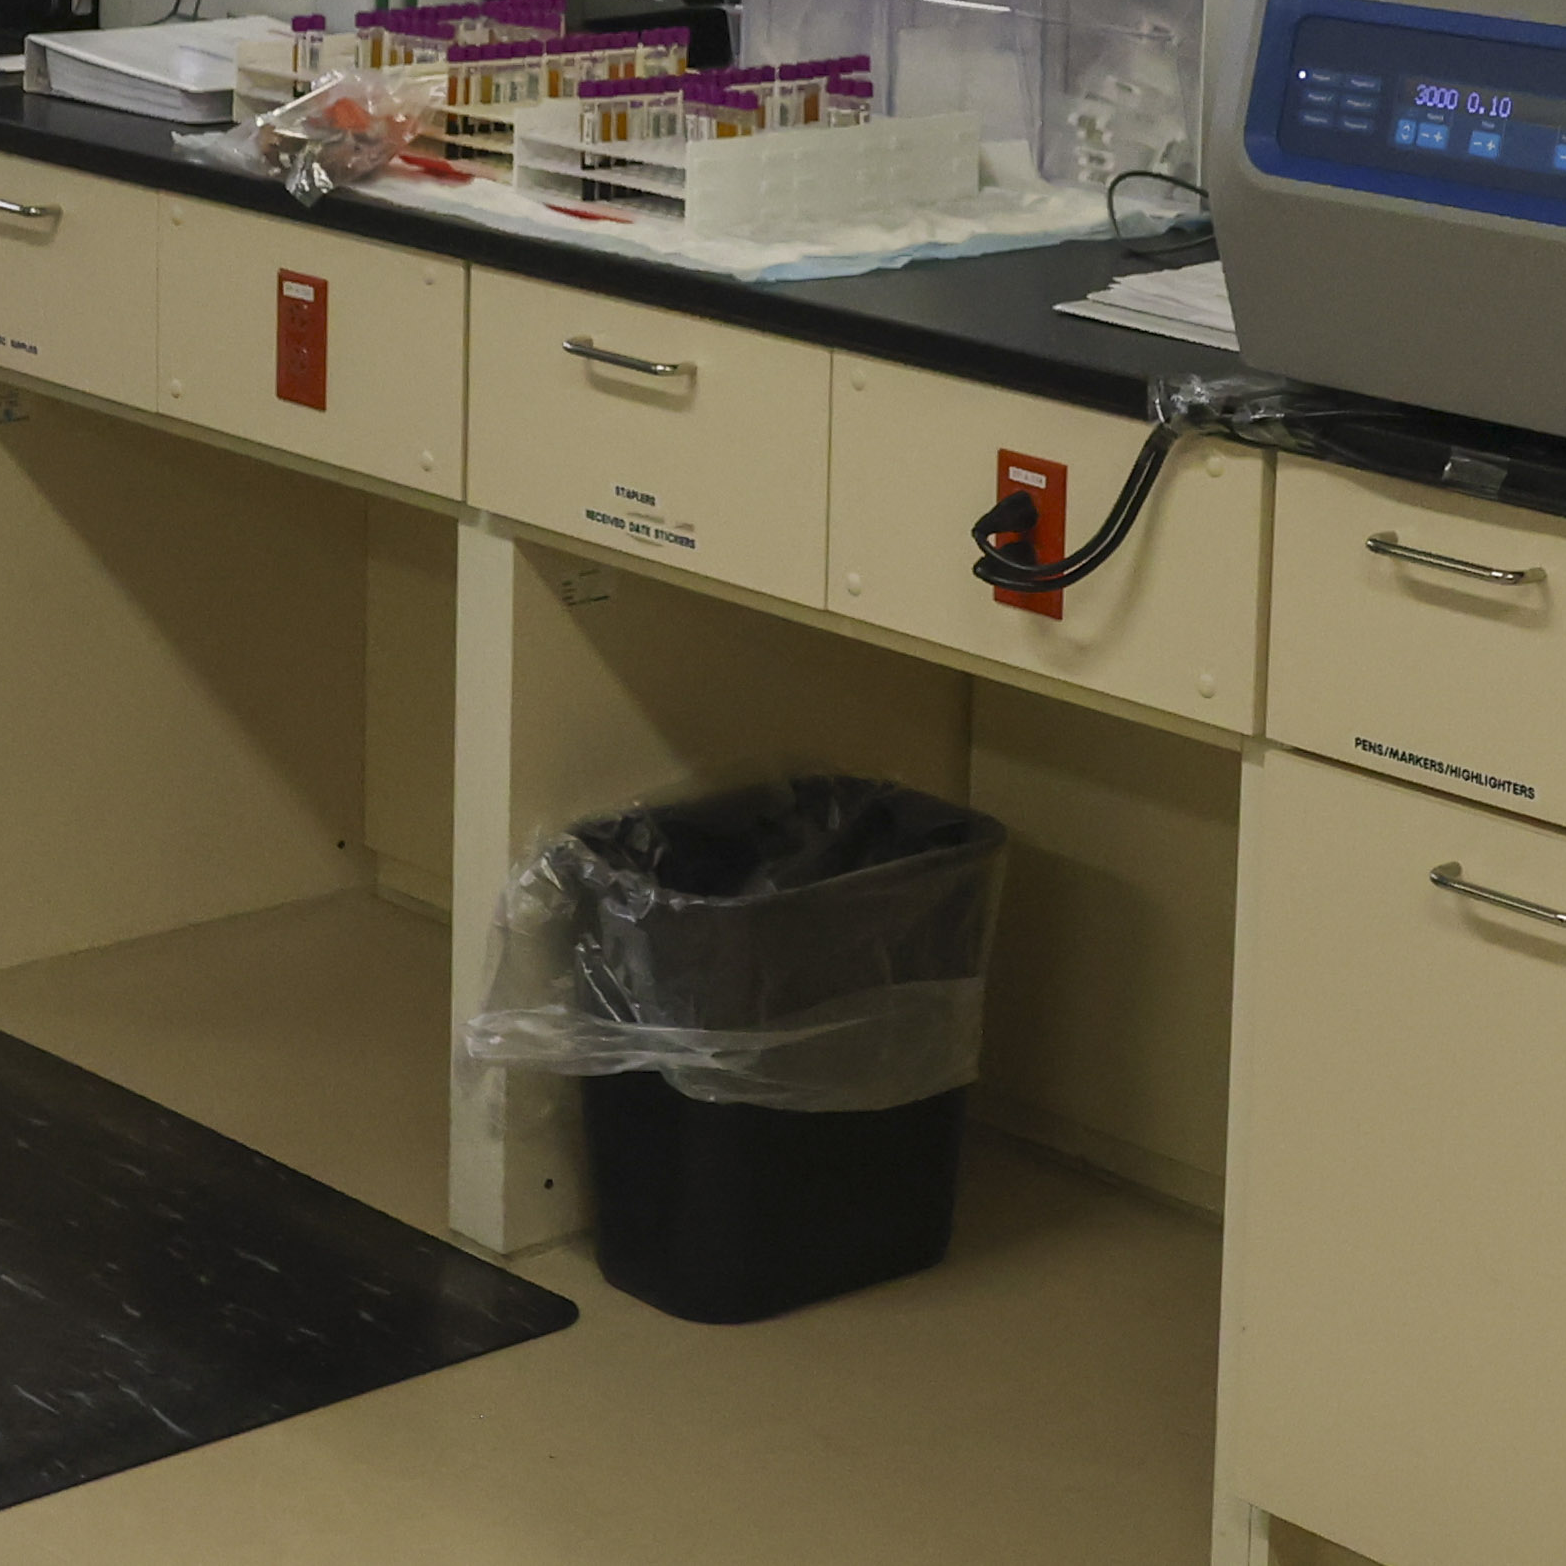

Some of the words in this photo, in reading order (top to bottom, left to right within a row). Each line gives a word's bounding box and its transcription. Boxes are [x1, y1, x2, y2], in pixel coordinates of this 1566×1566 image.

[1414, 84, 1459, 110] 3000
[1467, 92, 1512, 118] 0.10
[615, 485, 656, 507] STAPLERS
[629, 521, 651, 537] DATE
[1354, 736, 1536, 800] PENS/MARKERS/HIGHLIGHTERS
